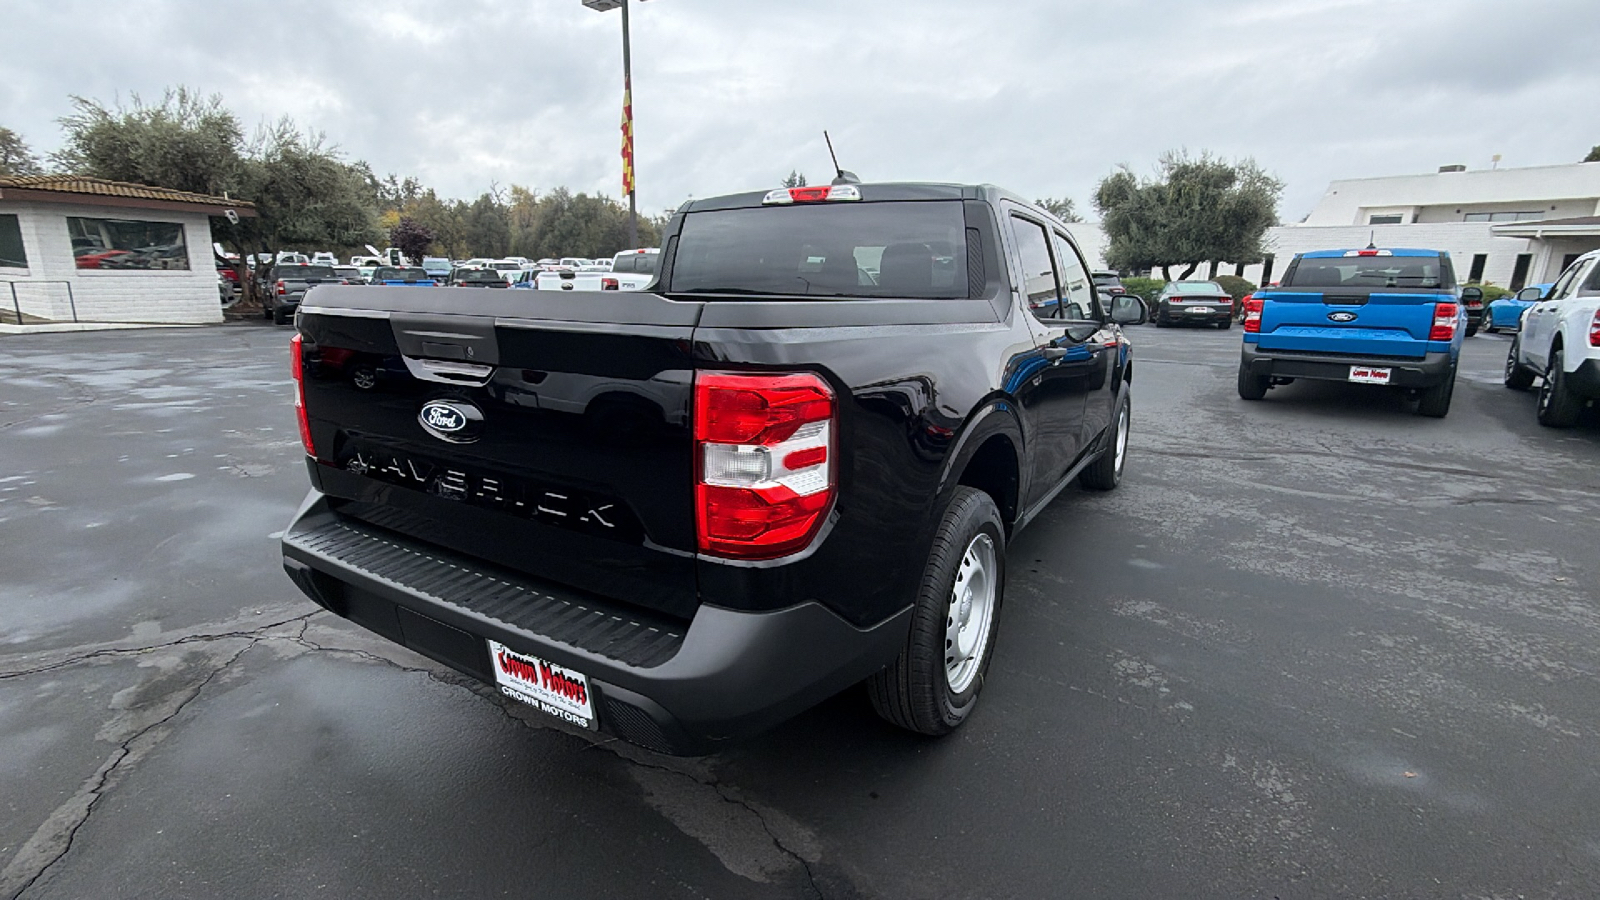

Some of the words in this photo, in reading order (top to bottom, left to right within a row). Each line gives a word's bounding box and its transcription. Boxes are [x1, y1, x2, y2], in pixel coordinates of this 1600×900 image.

[429, 407, 456, 427] Ford
[350, 453, 614, 528] MAVERICK
[498, 649, 538, 685] Crown
[539, 660, 587, 705] Motors
[502, 686, 539, 708] CROWN
[541, 702, 588, 728] MOTORS
